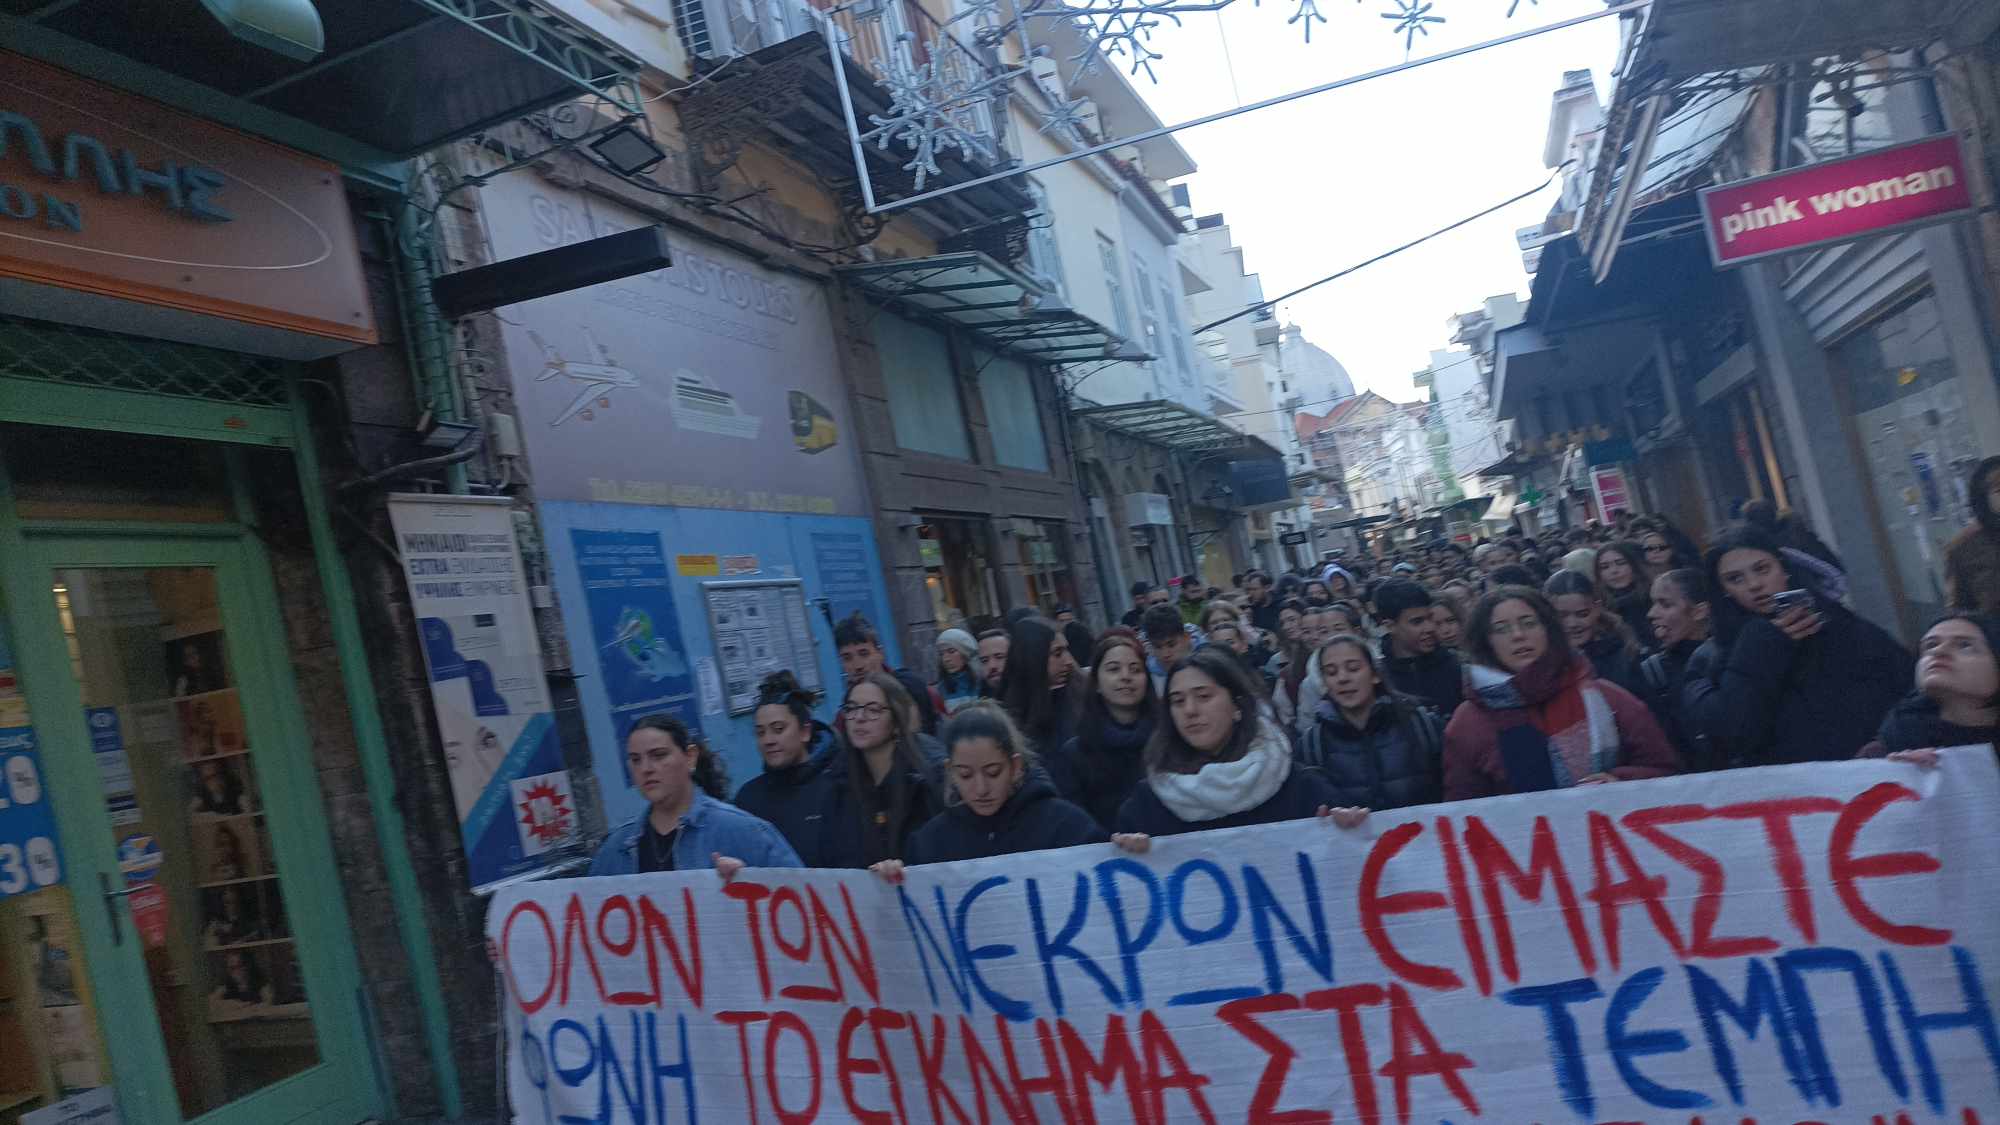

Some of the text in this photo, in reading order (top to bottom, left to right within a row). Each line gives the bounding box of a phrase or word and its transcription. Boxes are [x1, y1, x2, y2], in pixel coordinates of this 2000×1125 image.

[1721, 163, 1956, 242] pink woman
[722, 881, 882, 1006] ΤΩΝ
[896, 850, 1336, 1024] ΝΕΚΡΩΝ
[1358, 782, 1954, 998] ΕΙΜΑΣΤΕ
[1499, 945, 2000, 1121] ΤΕΜΠΗ
